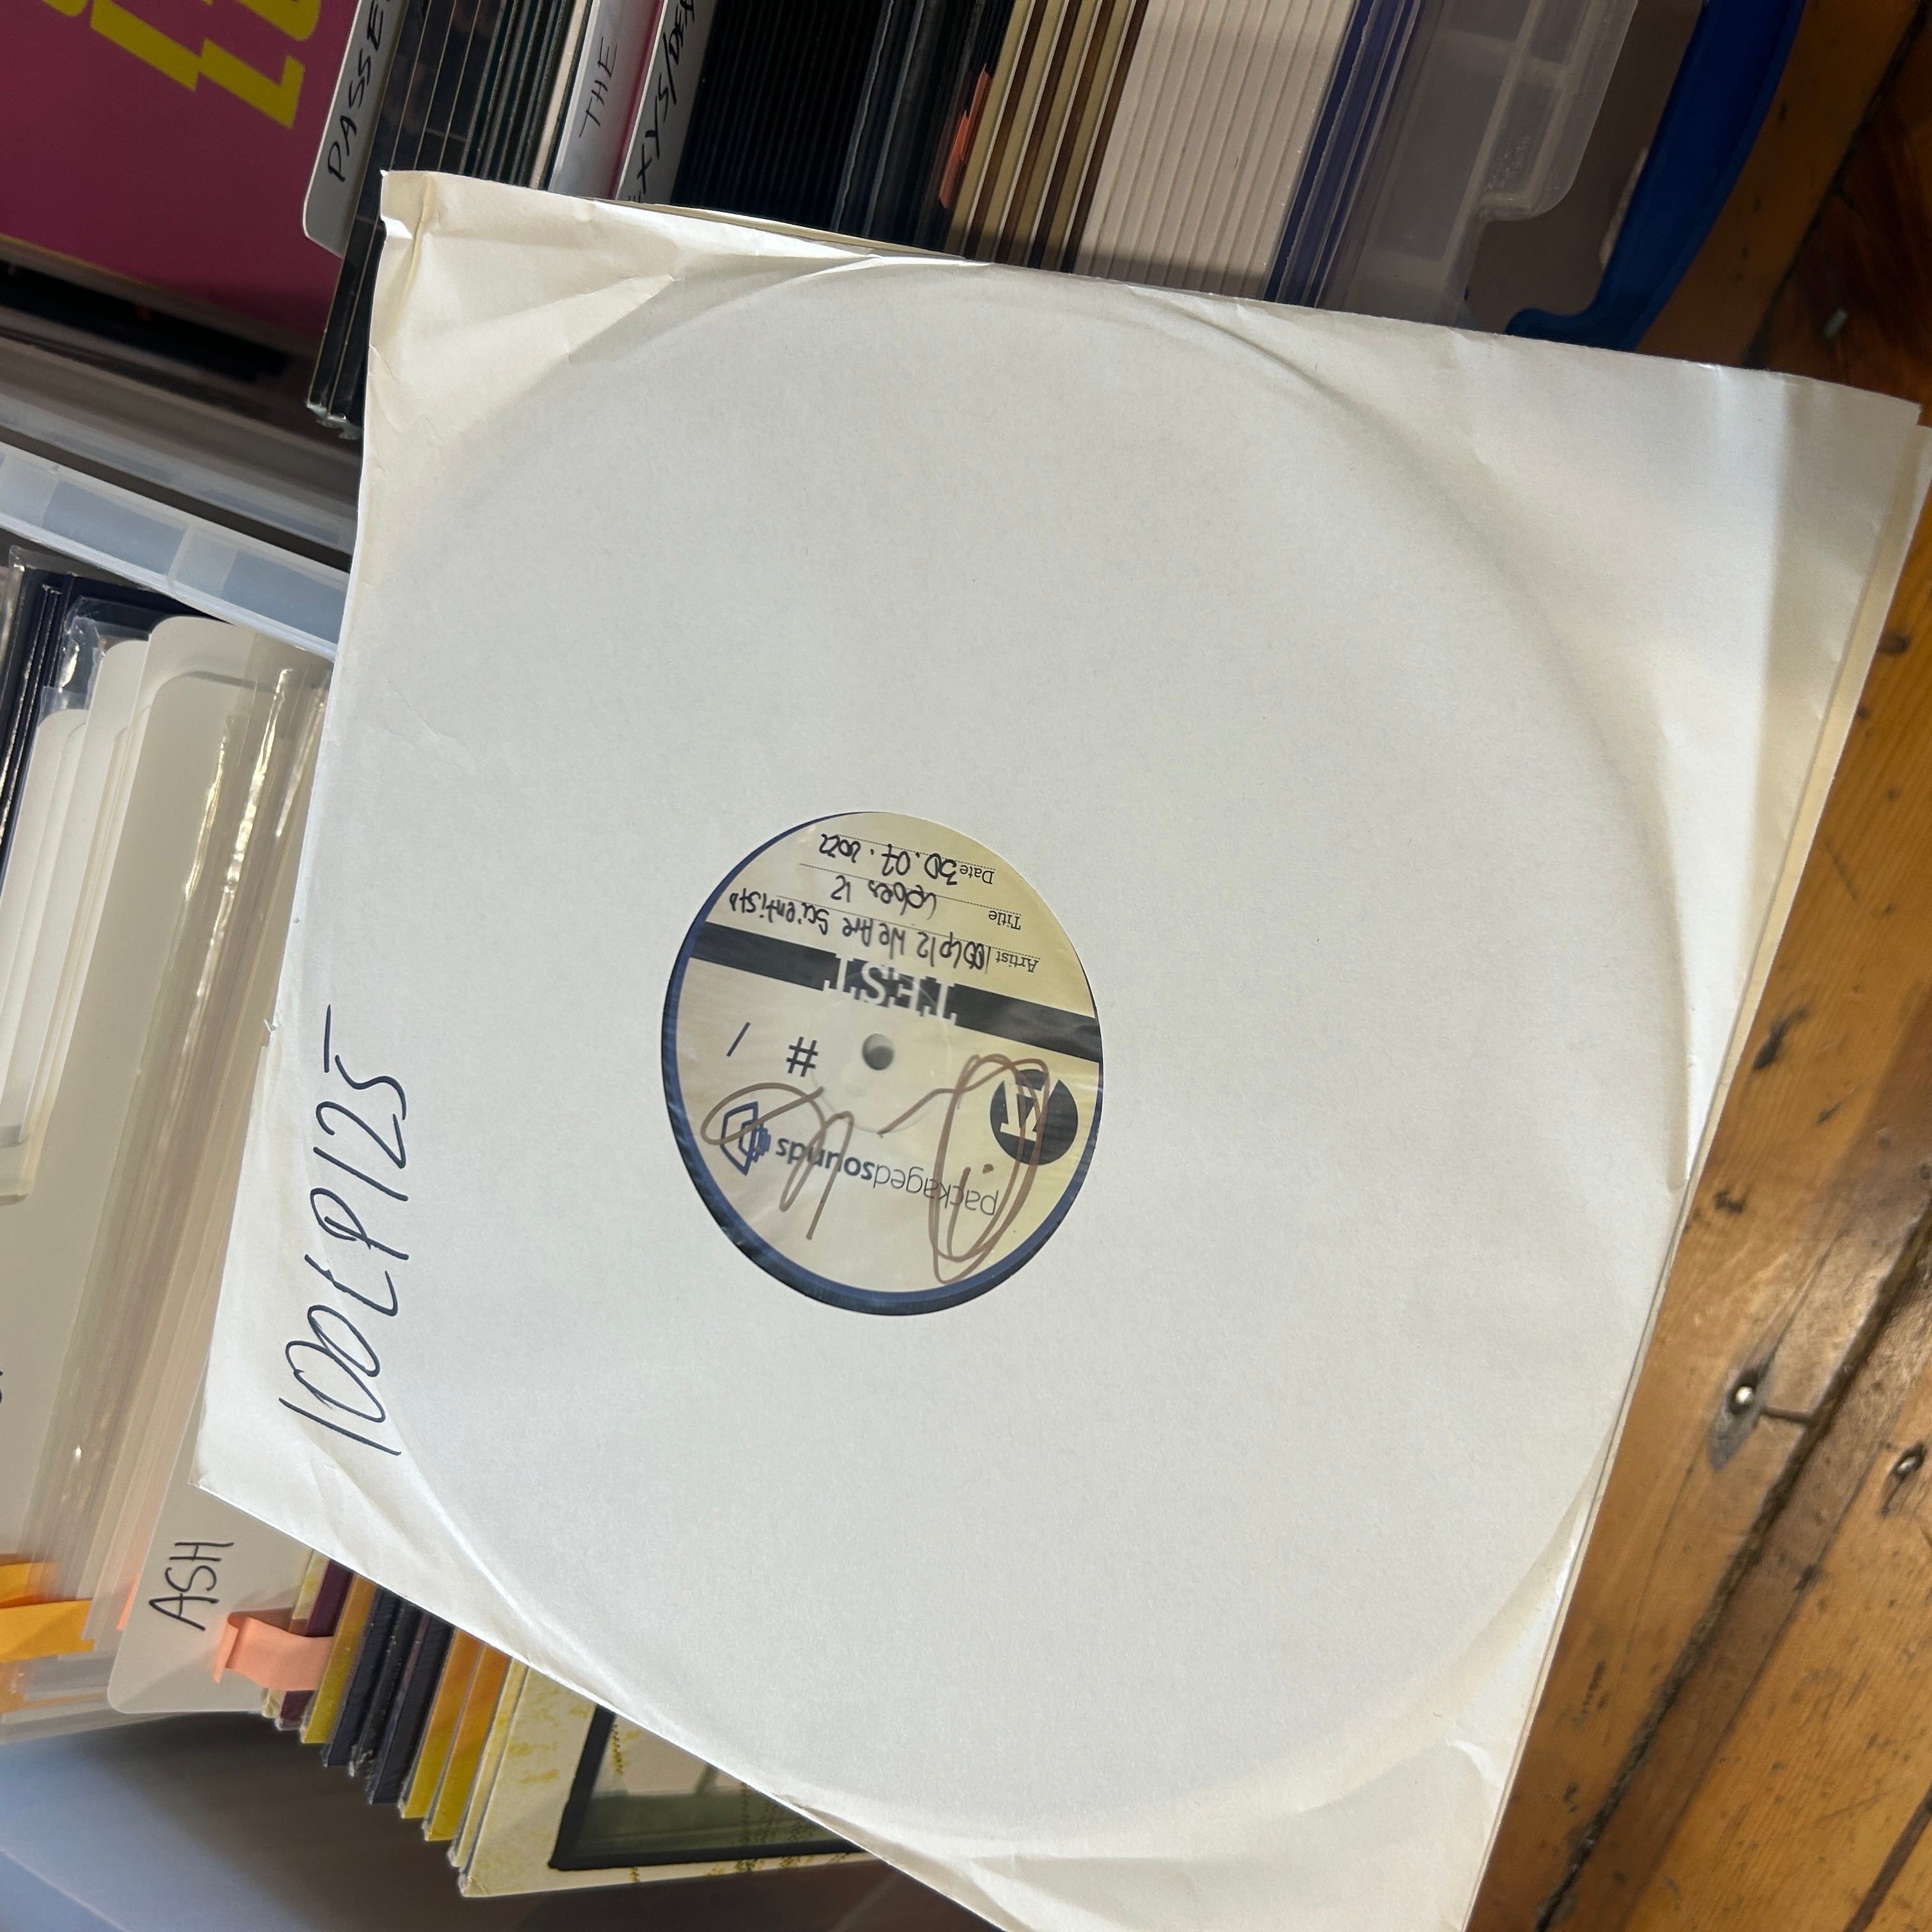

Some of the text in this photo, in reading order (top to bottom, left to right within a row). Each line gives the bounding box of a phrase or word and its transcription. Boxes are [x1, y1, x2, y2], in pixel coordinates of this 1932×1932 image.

[327, 0, 385, 182] PASSE
[578, 36, 618, 137] THE
[831, 875, 851, 902] 12
[959, 863, 995, 885] Date
[730, 887, 829, 935] Scientists
[988, 910, 1023, 931] Title
[842, 916, 874, 947] Are
[879, 928, 906, 960] We
[995, 947, 1041, 973] Artist
[824, 955, 958, 1021] TEST
[775, 1136, 999, 1216] packagedsounds
[149, 1542, 234, 1632] ASH
